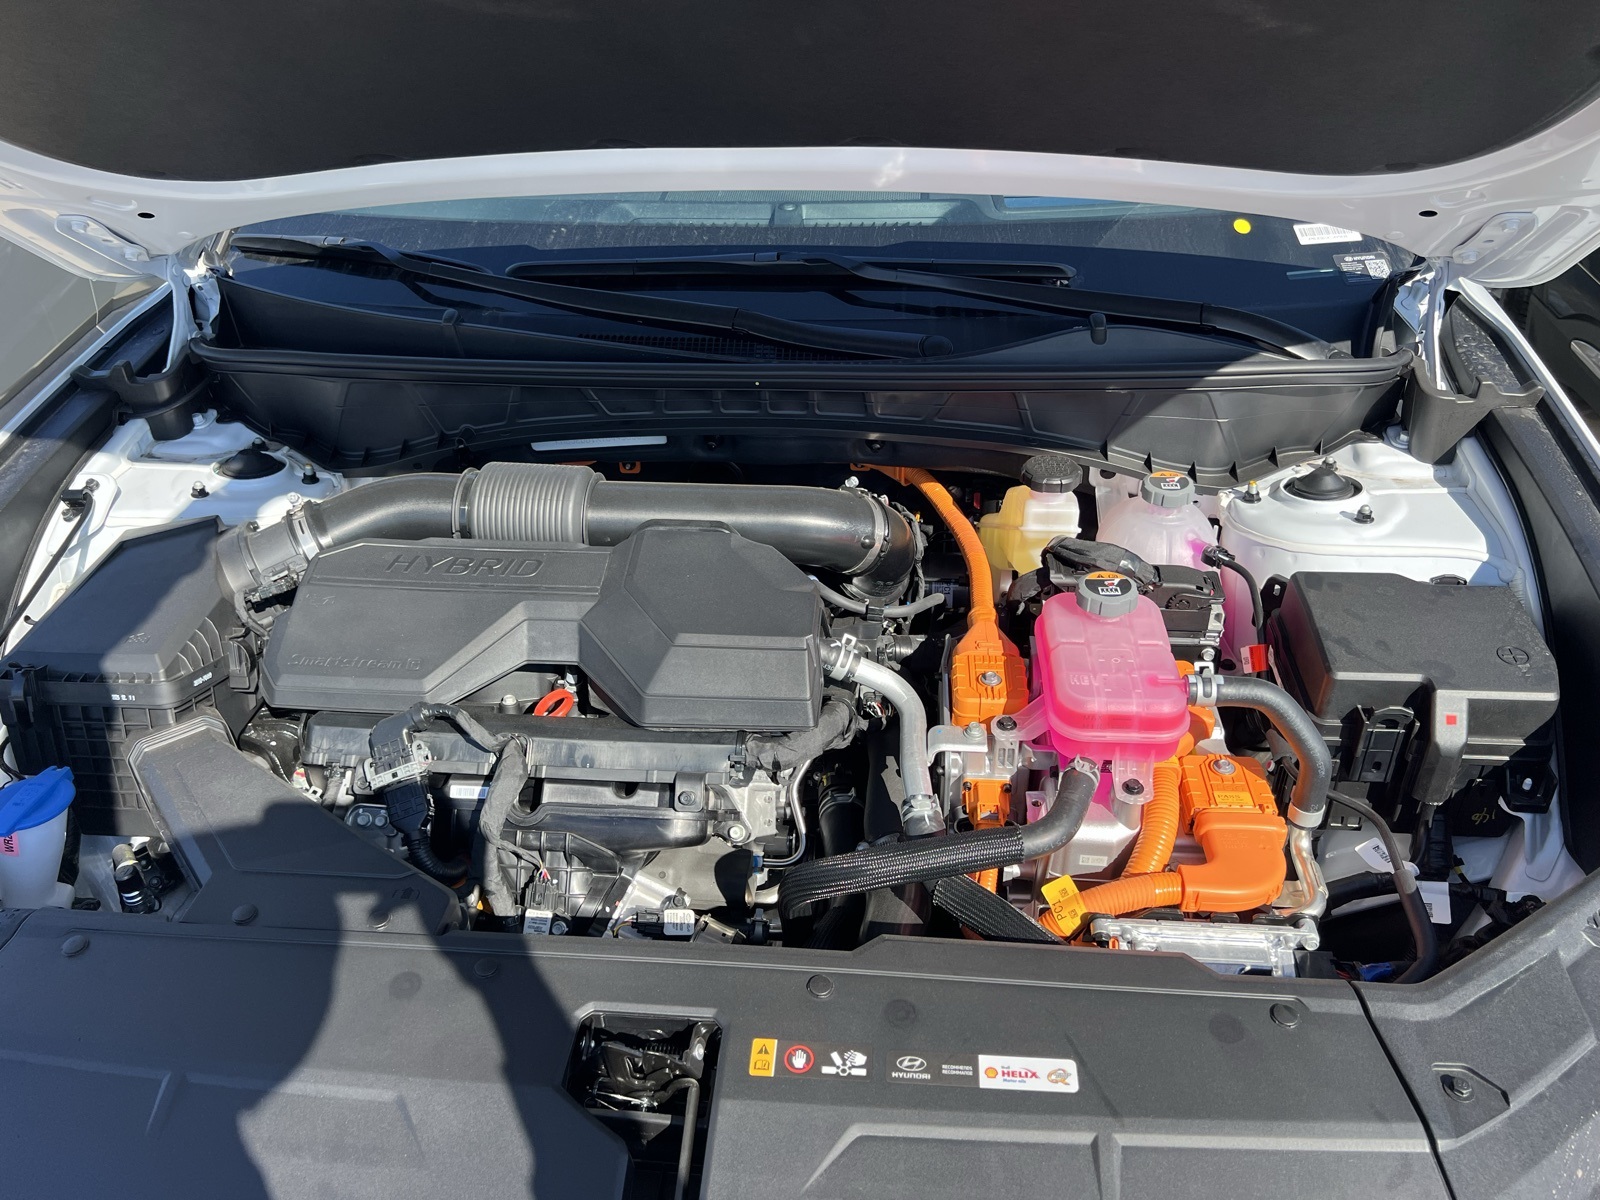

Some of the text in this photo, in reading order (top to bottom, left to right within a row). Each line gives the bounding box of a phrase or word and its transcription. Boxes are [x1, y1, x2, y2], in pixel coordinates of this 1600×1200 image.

[385, 554, 544, 577] HYBRID
[288, 654, 402, 669] Smartstream
[1052, 899, 1067, 921] PC1
[891, 1071, 931, 1080] HYUNDAI
[1001, 1068, 1040, 1079] HELIX
